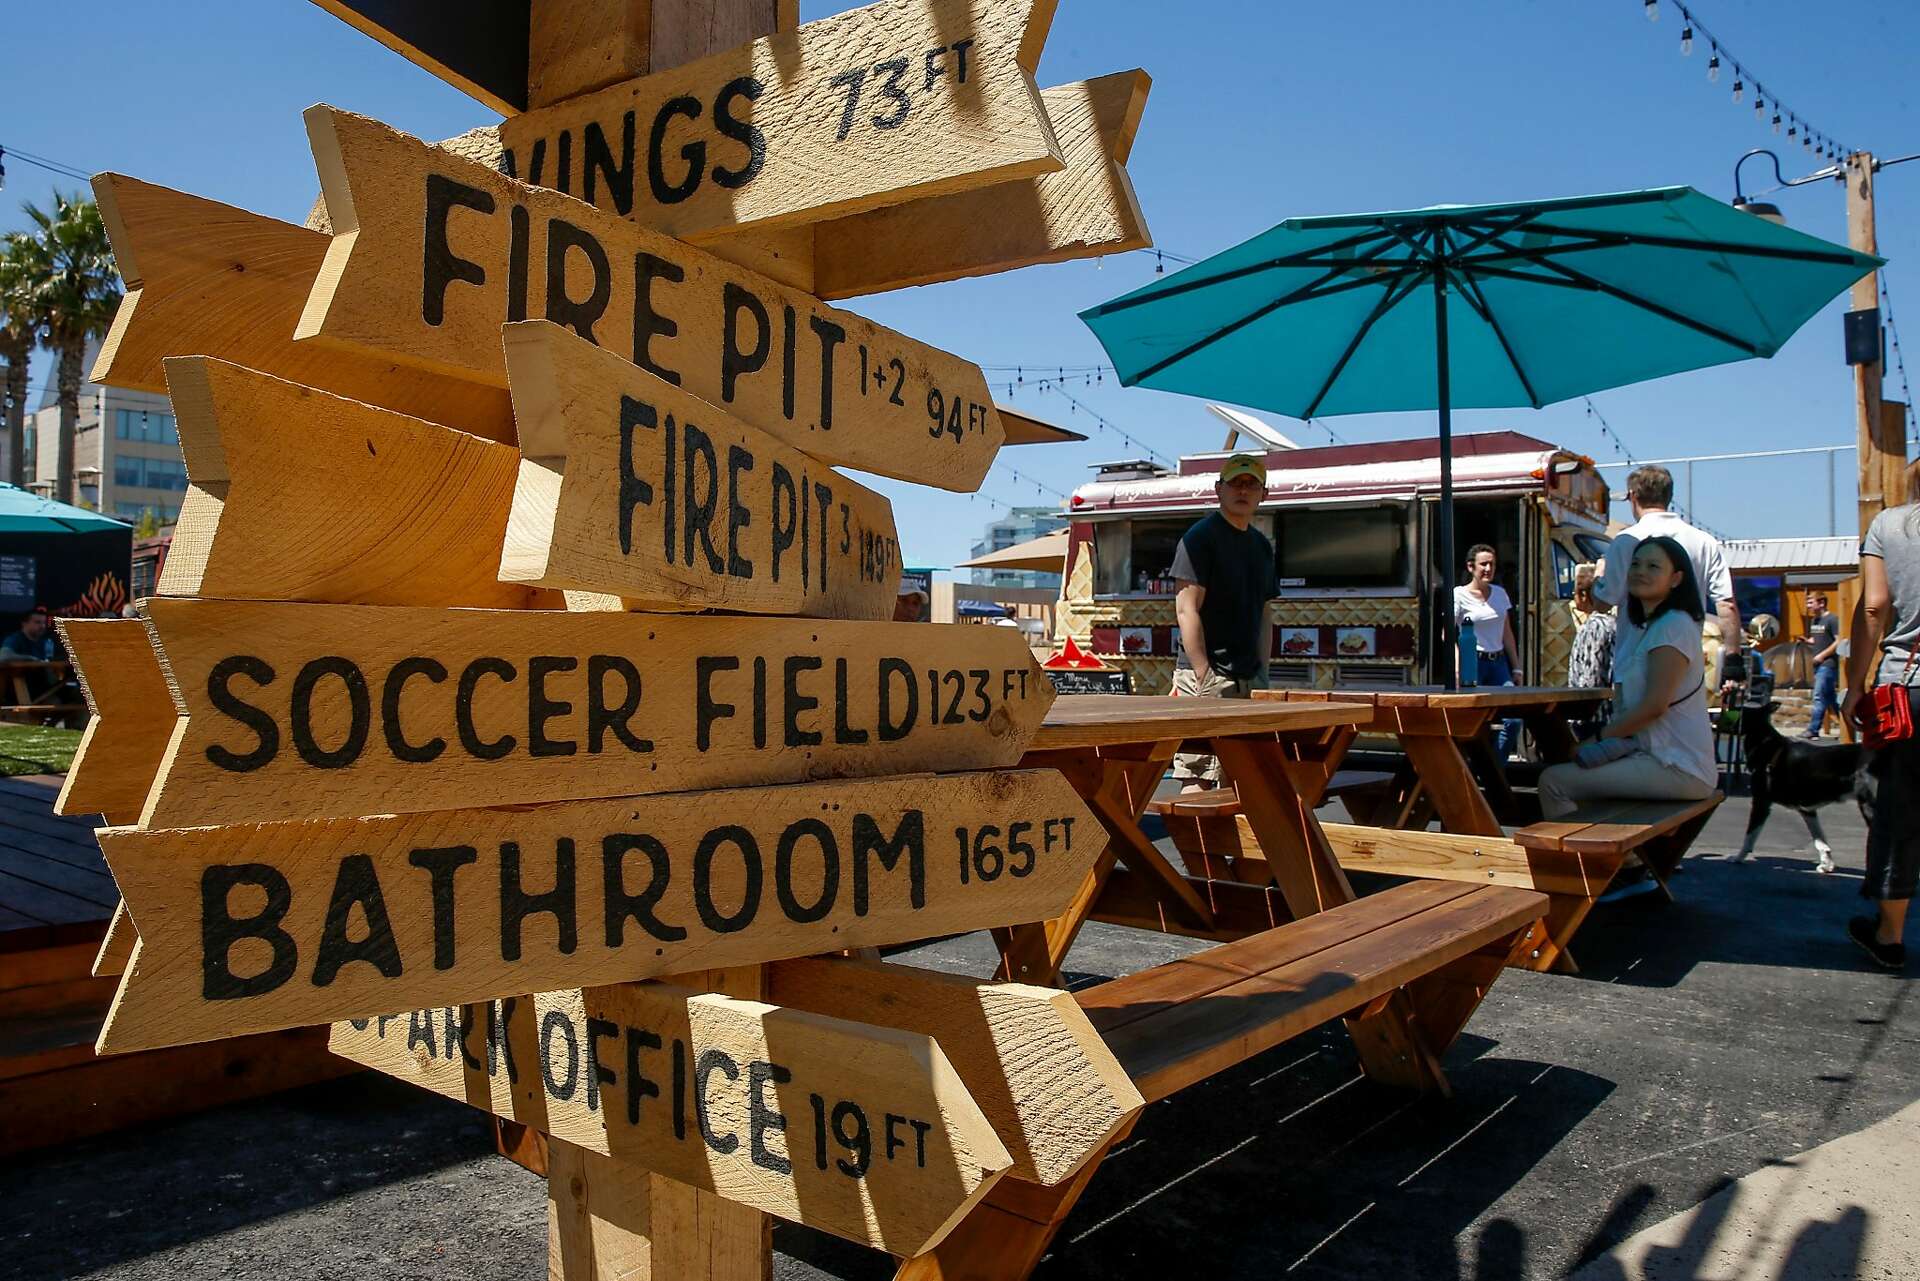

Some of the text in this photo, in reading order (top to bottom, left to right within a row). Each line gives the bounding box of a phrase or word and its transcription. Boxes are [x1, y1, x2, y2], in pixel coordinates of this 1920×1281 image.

[830, 55, 912, 142] 73
[925, 38, 975, 92] FT
[422, 173, 987, 444] FIRE PIT 1+2 94 FT
[618, 394, 754, 580] FIRE
[771, 461, 833, 595] PIT
[840, 502, 850, 555] 3
[886, 536, 896, 569] FT
[205, 655, 1029, 773] SOCCER FIELD 123 FT
[202, 809, 1076, 1000] BATHROOM 165 FT
[350, 998, 932, 1179] ARK OFFICE 19 FT
